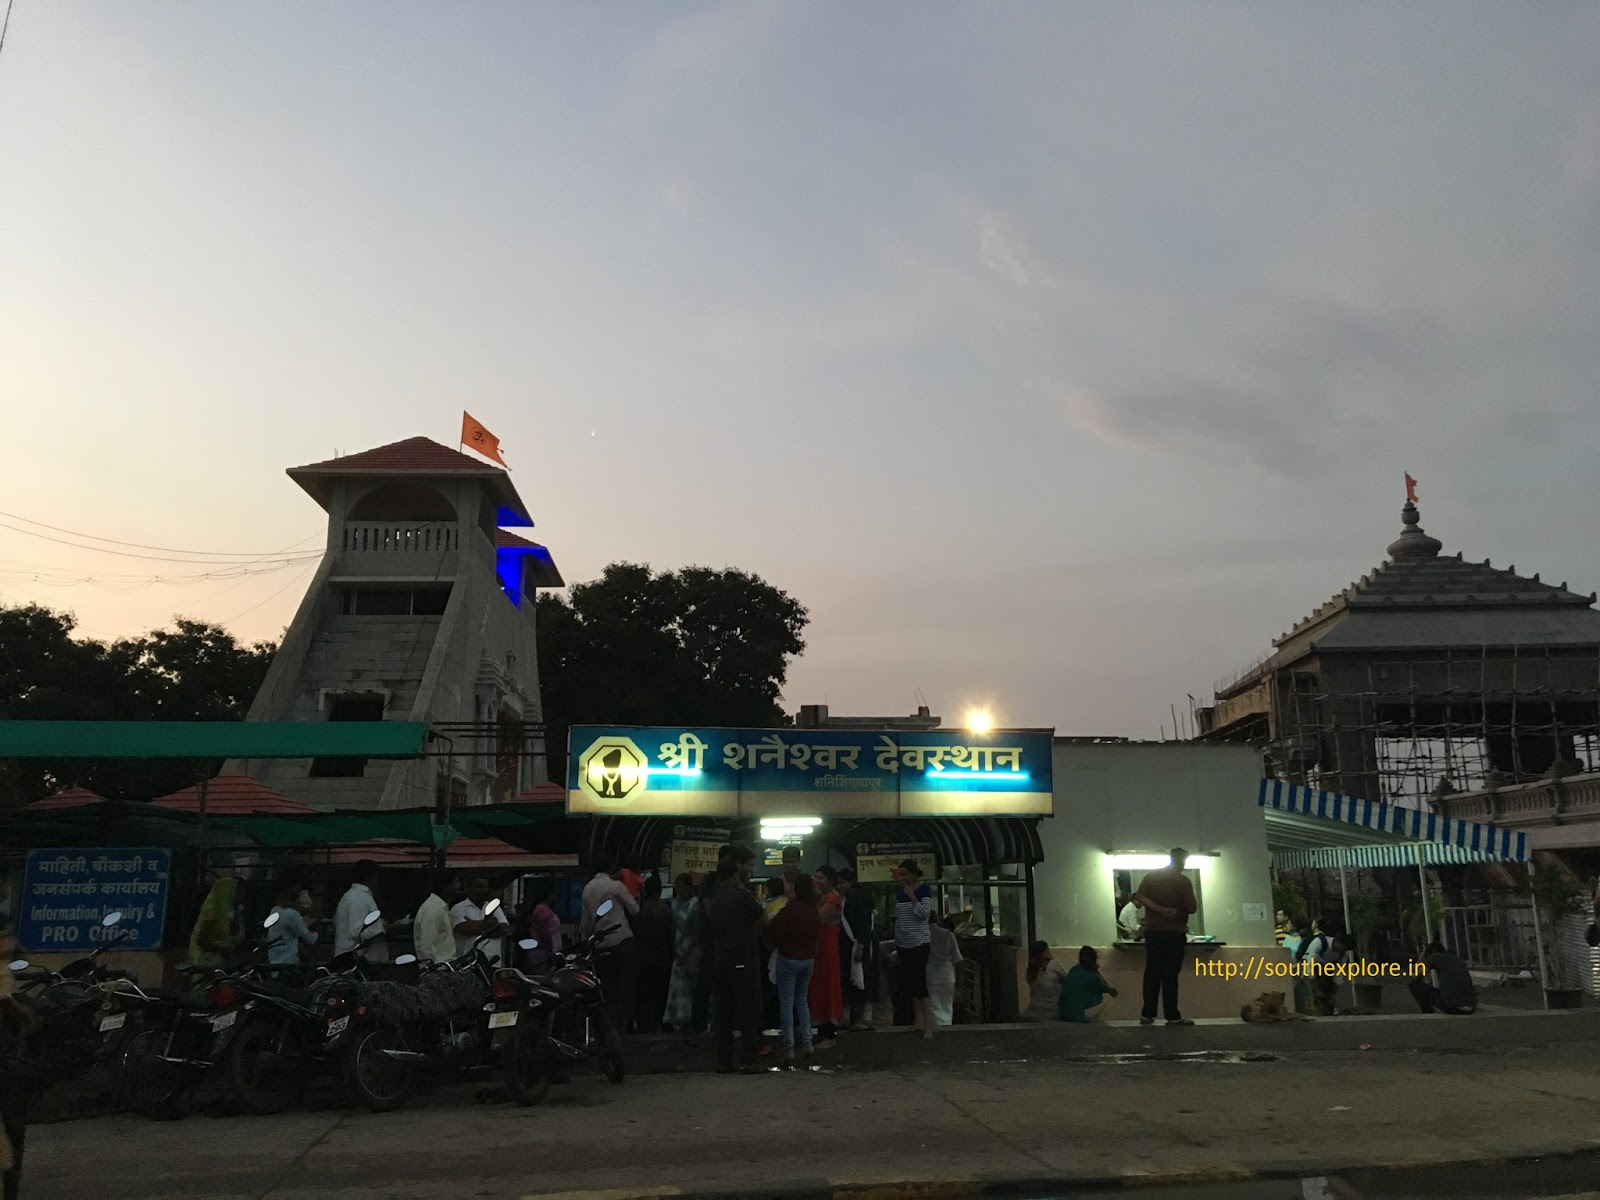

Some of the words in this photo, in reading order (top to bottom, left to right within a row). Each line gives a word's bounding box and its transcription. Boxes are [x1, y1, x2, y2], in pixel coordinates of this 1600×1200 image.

[657, 732, 708, 769] श्री
[723, 734, 861, 770] शनैश्वर
[873, 735, 1023, 773] देवस्थान
[147, 860, 159, 872] व
[32, 878, 98, 896] जनसंपर्क
[100, 877, 161, 896] कार्यालय
[103, 904, 144, 923] Iuiry
[146, 902, 155, 919] &
[42, 926, 79, 943] PRO
